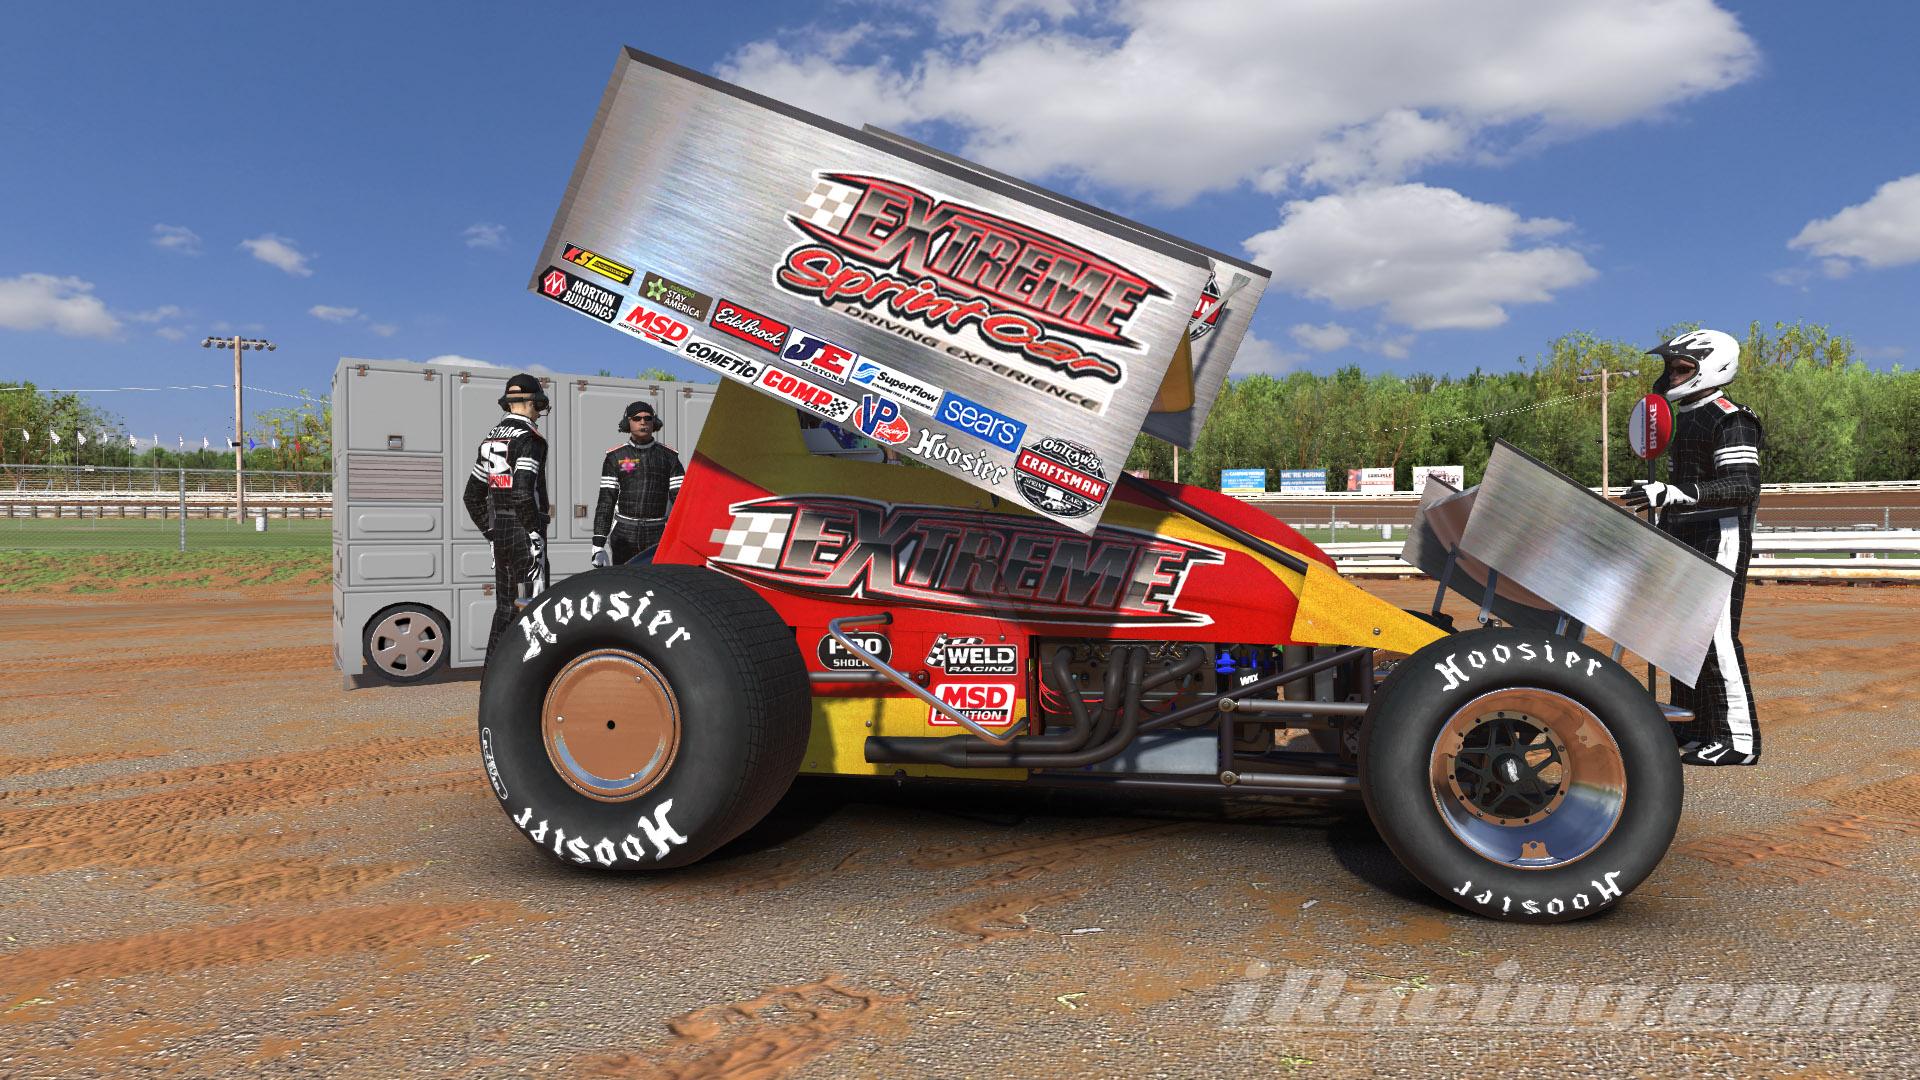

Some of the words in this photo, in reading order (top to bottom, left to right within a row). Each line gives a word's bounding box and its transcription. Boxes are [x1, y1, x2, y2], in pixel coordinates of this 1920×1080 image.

[841, 188, 1148, 337] EXTREME
[563, 290, 616, 321] BUILDINGS
[572, 280, 616, 307] MORTON
[663, 297, 700, 318] AMERICA
[667, 290, 687, 303] STAY
[625, 305, 689, 342] MSD
[715, 307, 787, 347] Edelbrock
[781, 249, 988, 325] Sprint
[983, 314, 1119, 377] Car
[685, 341, 758, 378] COMETIC
[791, 336, 853, 375] JE
[801, 361, 845, 384] PISTONS
[844, 305, 942, 348] DRIVING
[946, 346, 1101, 409] EXPERIENCE
[762, 368, 833, 406] COMP
[877, 371, 939, 403] SuperFlow
[804, 400, 838, 418] CAMS
[862, 395, 899, 436] VP
[944, 398, 1018, 445] sears
[1649, 403, 1657, 450] BRAKE
[877, 424, 908, 439] Racing
[909, 428, 1007, 485] Hoosier
[1021, 454, 1101, 496] CRAFTSMAN
[1024, 478, 1046, 490] SPRINT
[1064, 494, 1084, 506] CARS
[782, 505, 1194, 613] EXTREME
[519, 590, 691, 662] Hoosier
[833, 658, 870, 667] SHOCK
[948, 648, 1015, 664] WELD
[1434, 640, 1602, 691] Hoosier
[942, 686, 1008, 708] MSD
[1240, 673, 1259, 686] WIX
[513, 798, 688, 867] Hoosier
[1453, 871, 1622, 915] Hoosier
